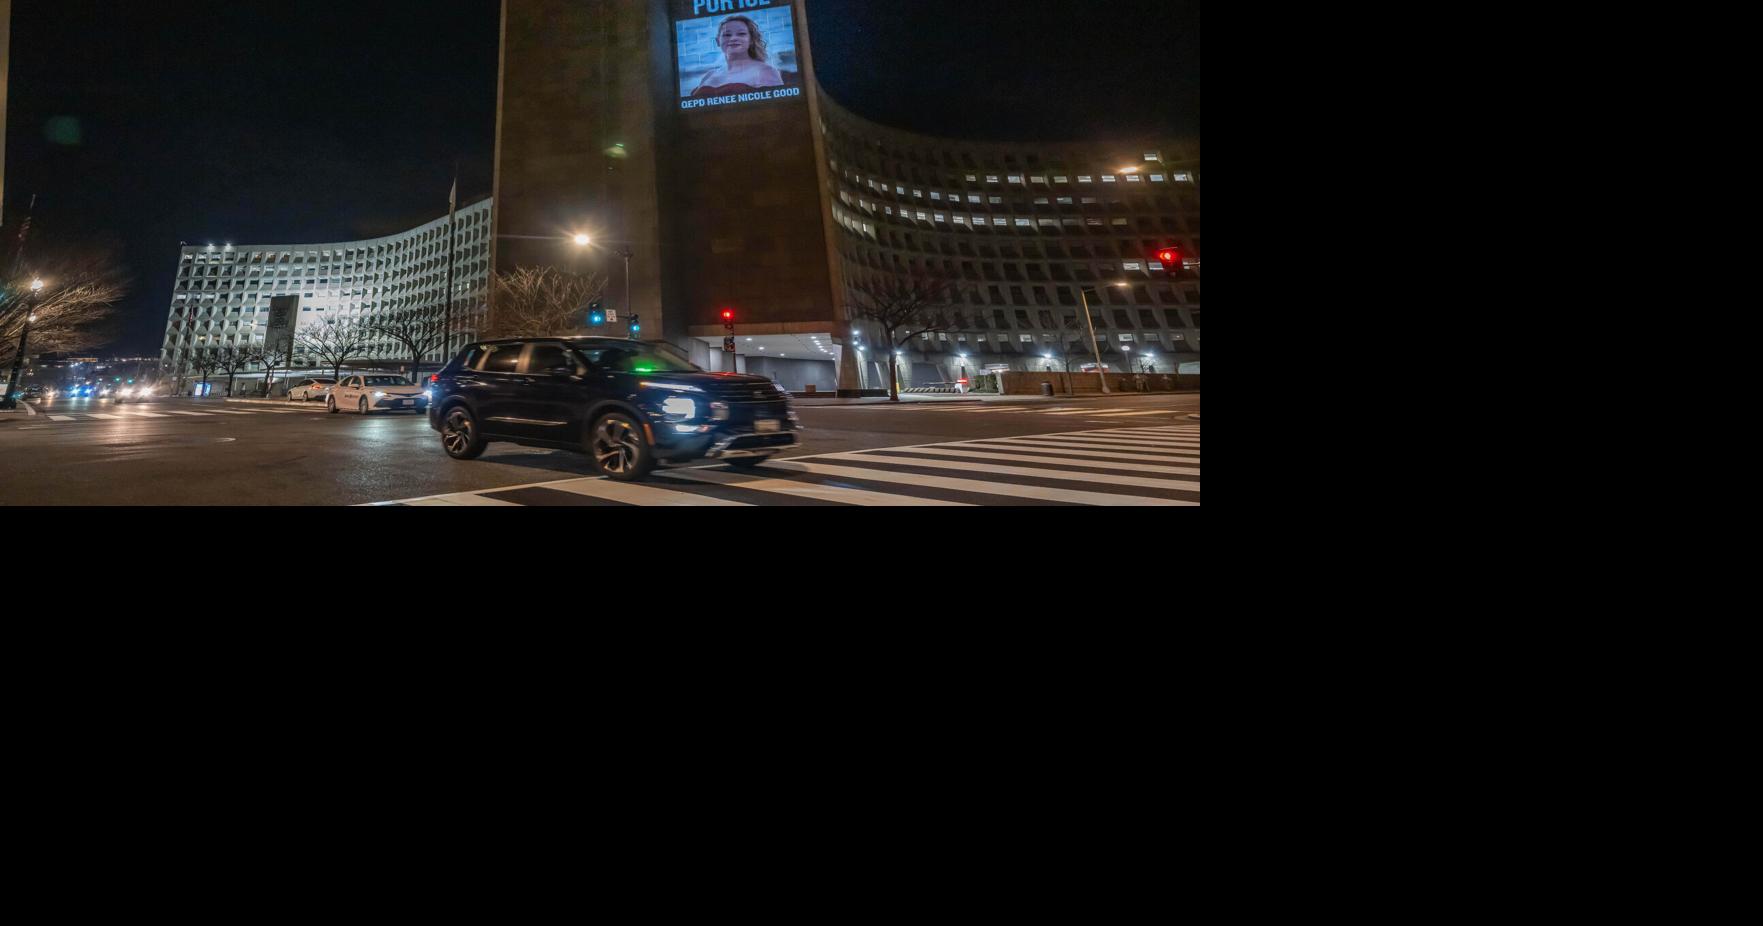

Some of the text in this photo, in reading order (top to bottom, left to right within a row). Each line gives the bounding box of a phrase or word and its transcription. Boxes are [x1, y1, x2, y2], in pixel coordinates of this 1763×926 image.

[707, 95, 737, 106] RENEE
[738, 91, 772, 102] NICOLE
[773, 87, 800, 98] GOOD
